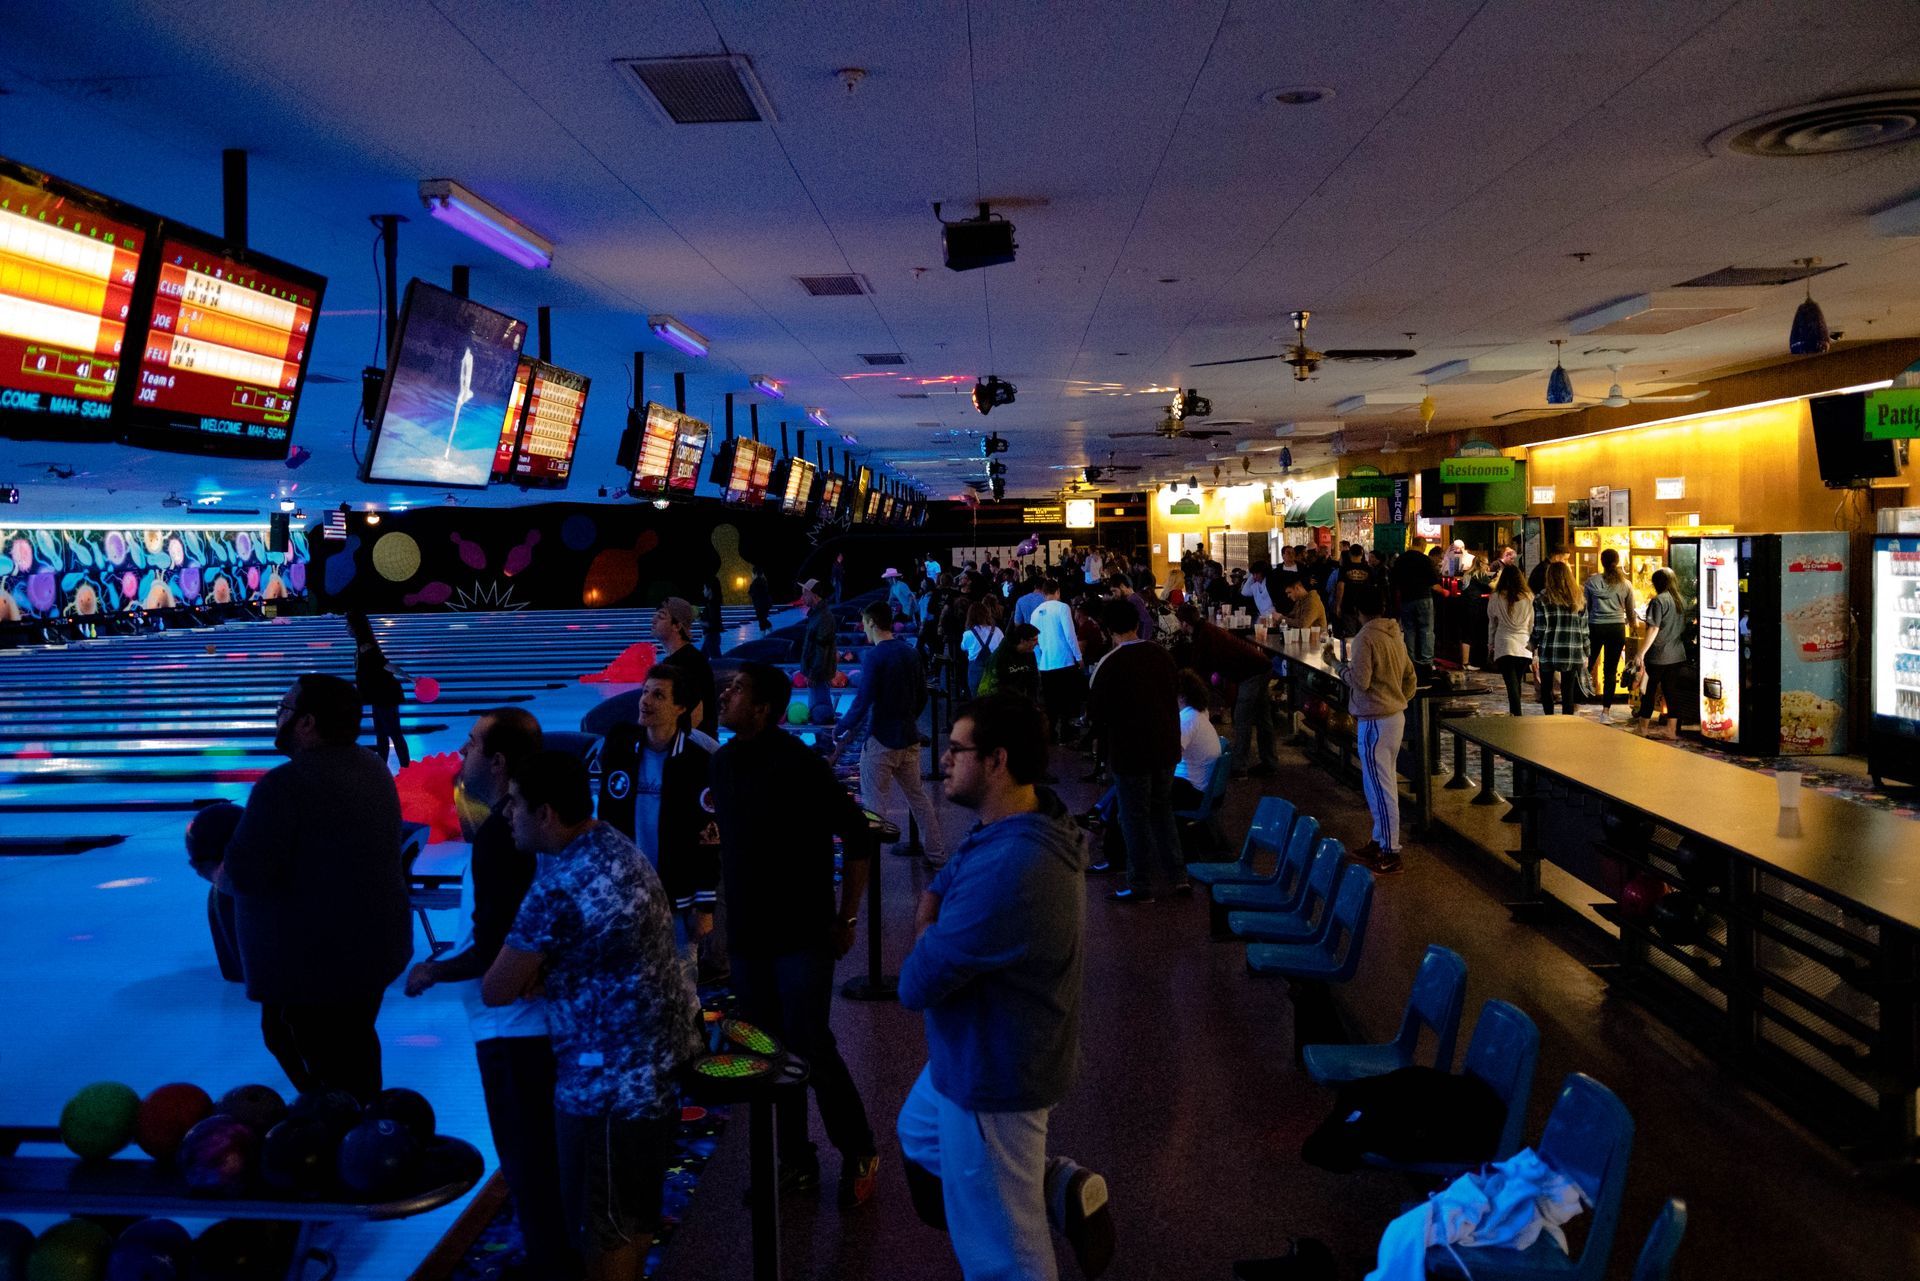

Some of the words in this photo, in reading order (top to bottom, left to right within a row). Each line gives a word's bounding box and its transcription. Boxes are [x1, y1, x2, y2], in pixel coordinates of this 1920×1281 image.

[21, 204, 28, 215] 5
[39, 211, 46, 221] 6
[74, 222, 81, 232] 8
[90, 227, 97, 237] 9
[103, 233, 114, 243] 10
[122, 269, 135, 283] 26
[160, 280, 184, 297] CLEM
[121, 305, 129, 318] 9
[153, 313, 171, 328] JOE
[114, 341, 121, 352] 6
[146, 348, 168, 361] FELI
[297, 351, 303, 360] 6
[37, 355, 47, 370] 0
[76, 363, 89, 377] 41
[103, 369, 116, 382] 41
[143, 371, 167, 387] Team
[167, 376, 175, 387] 6
[138, 388, 157, 402] JOE
[241, 393, 248, 404] 0
[265, 396, 274, 408] 58
[281, 401, 292, 411] 58
[1878, 403, 1920, 431] Party
[677, 462, 694, 478] EVENT
[1446, 464, 1509, 477] Restrooms
